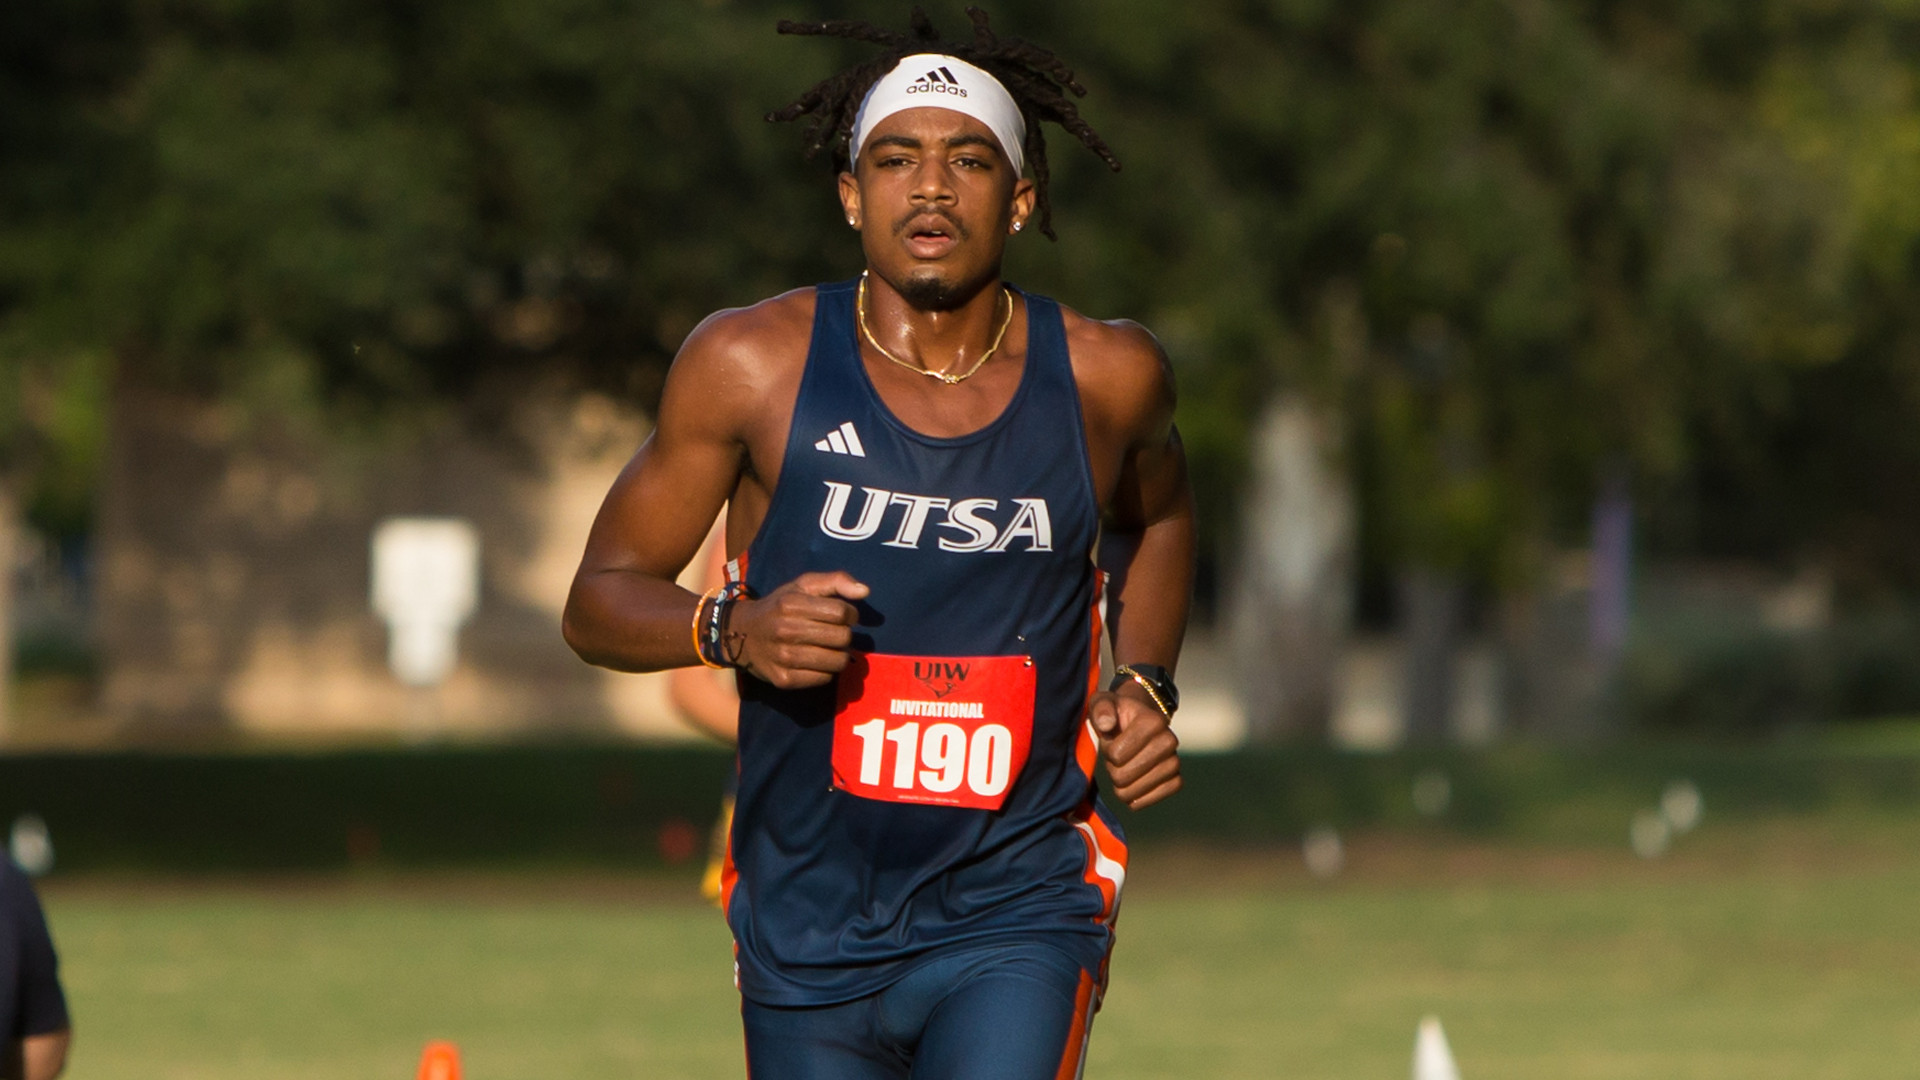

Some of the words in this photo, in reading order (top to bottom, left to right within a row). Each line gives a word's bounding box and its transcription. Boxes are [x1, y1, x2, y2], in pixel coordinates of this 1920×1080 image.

[907, 82, 967, 97] adidas
[819, 480, 1053, 552] UTSA
[914, 662, 970, 681] UIW
[890, 699, 984, 719] INVITATIONAL
[852, 718, 1012, 796] 1190
